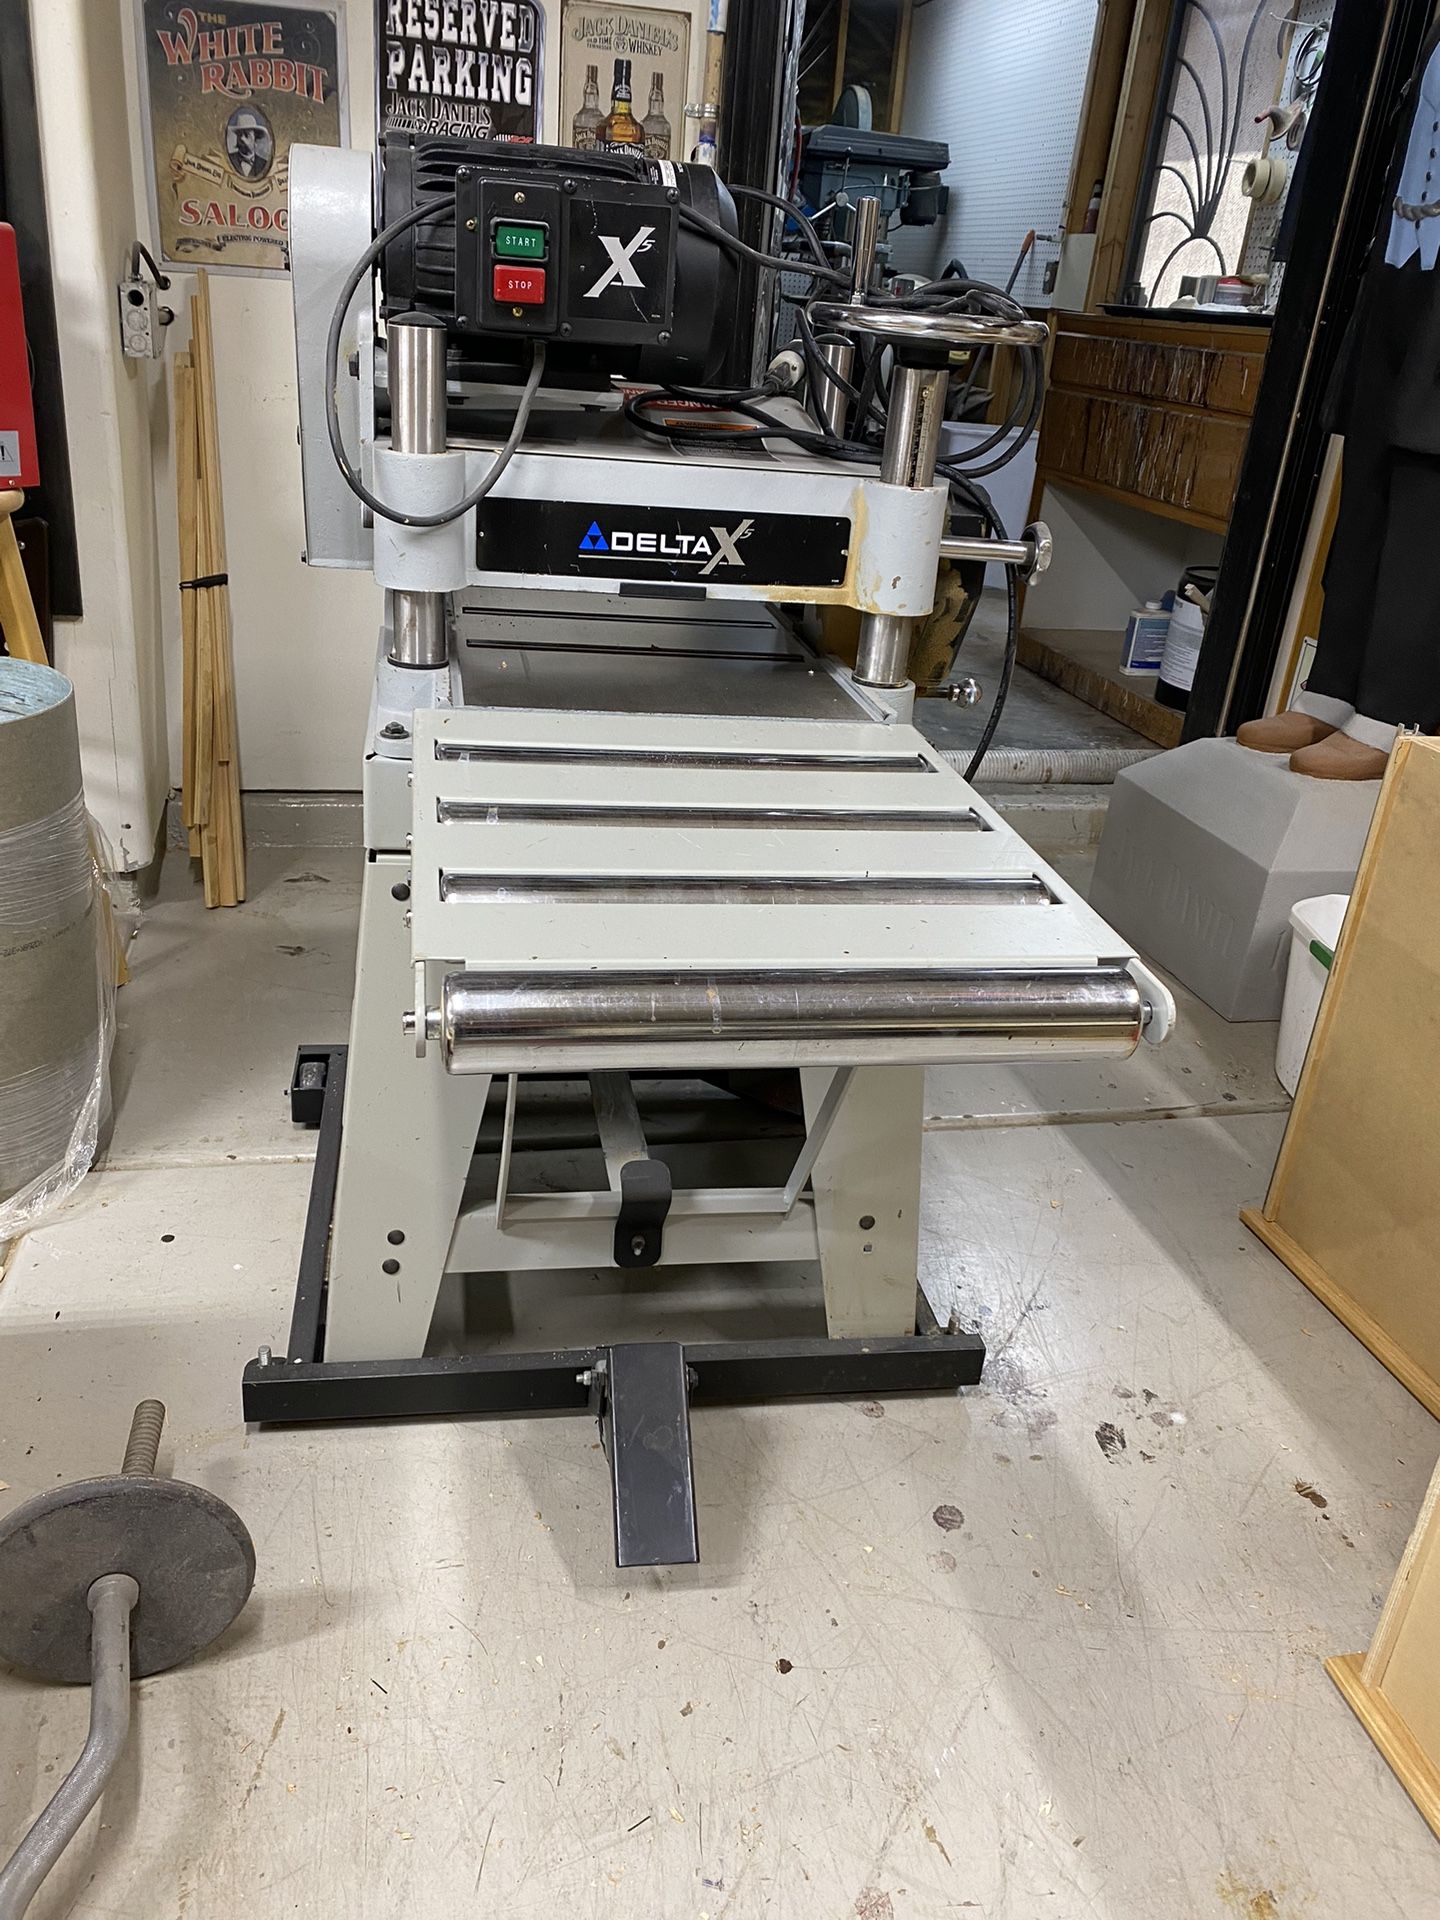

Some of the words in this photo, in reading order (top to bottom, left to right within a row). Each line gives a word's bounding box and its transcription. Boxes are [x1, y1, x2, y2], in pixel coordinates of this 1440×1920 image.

[197, 12, 227, 25] THE
[386, 0, 535, 53] RESERVED
[572, 16, 614, 42] JACK
[615, 15, 679, 52] DANIEL'S
[157, 8, 284, 65] WHITE
[628, 38, 663, 56] WHISKEY
[201, 59, 328, 104] RABBIT
[386, 40, 533, 106] PARKING
[385, 91, 427, 118] JACK
[430, 96, 492, 126] DANIEL'S
[426, 119, 490, 140] RACING
[179, 199, 289, 232] SALOO
[505, 235, 537, 248] START
[508, 280, 533, 290] STOP
[611, 531, 713, 555] DELTA
